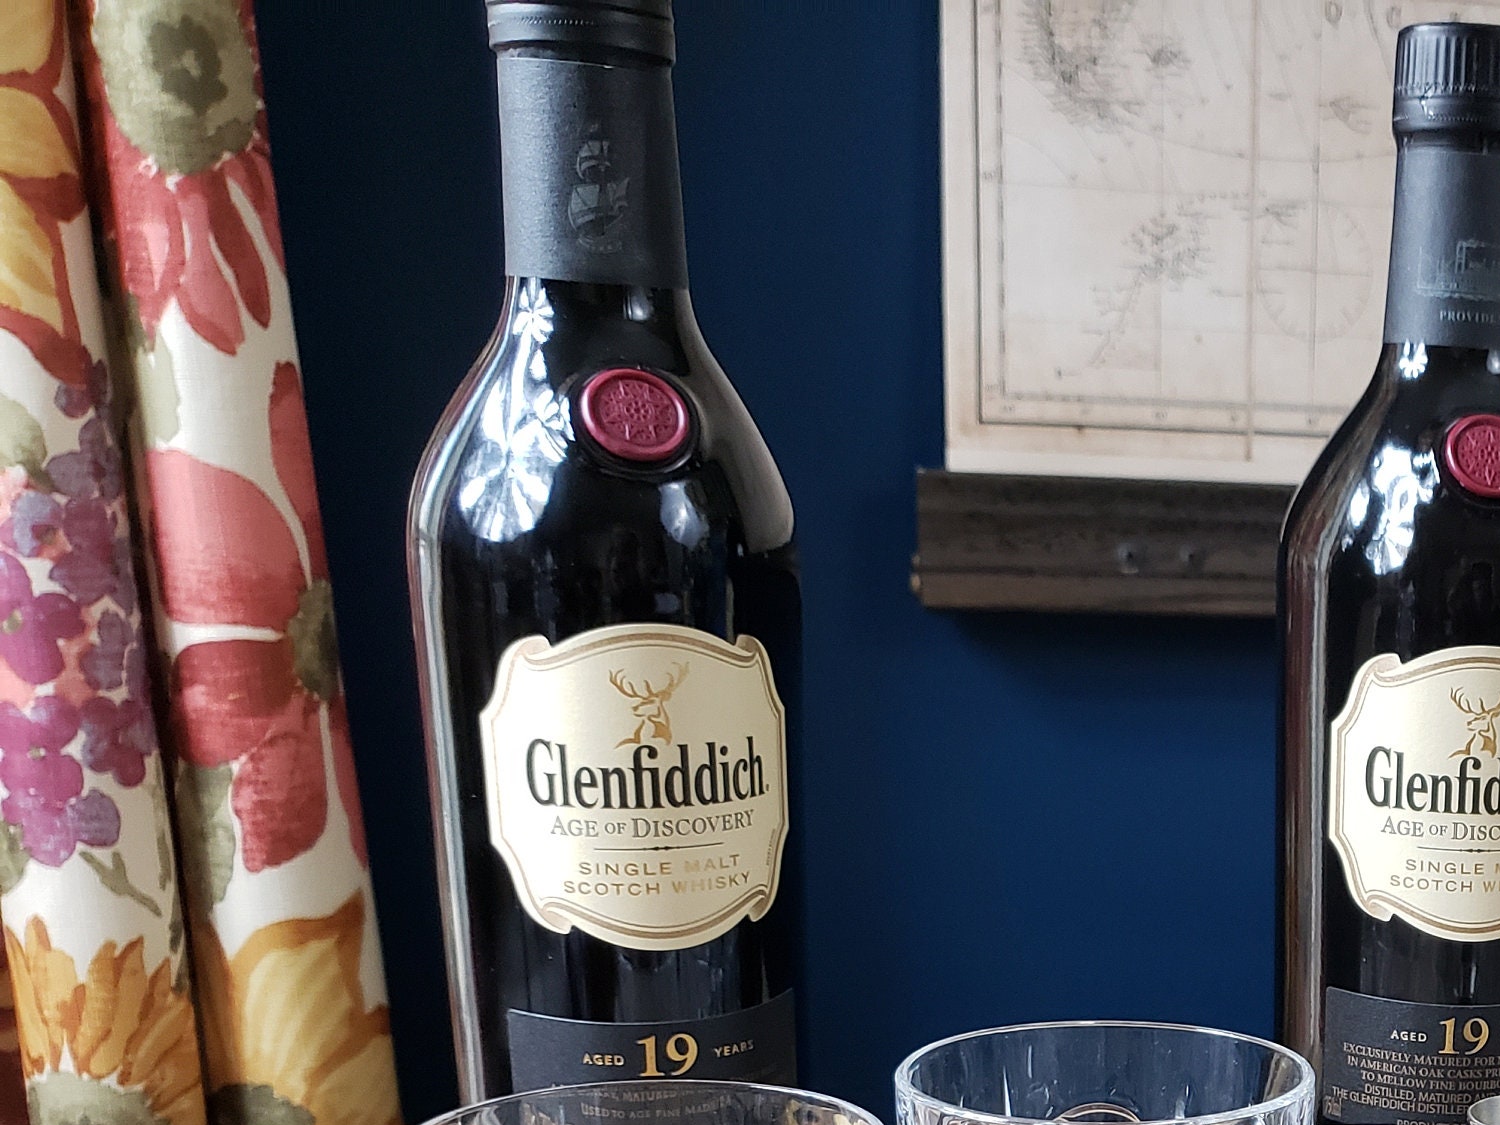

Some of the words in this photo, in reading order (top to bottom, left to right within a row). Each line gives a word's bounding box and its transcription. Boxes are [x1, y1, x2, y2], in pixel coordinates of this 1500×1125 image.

[526, 736, 767, 810] Glenfiddich
[550, 815, 600, 838] AGE
[604, 822, 627, 835] OF
[631, 809, 754, 839] DISCOVERY
[1381, 815, 1425, 838] AGE
[1428, 824, 1449, 837] OF
[579, 861, 672, 876] SINGLE
[683, 854, 740, 873] MALT
[1405, 858, 1485, 875] SINGLE
[564, 880, 661, 896] SCOTCH
[672, 871, 750, 894] WHISKY
[1390, 874, 1473, 893] SCOTCH
[1390, 1029, 1427, 1042] AGED
[1438, 1017, 1490, 1056] 19
[582, 1053, 625, 1067] AGED
[636, 1033, 699, 1077] 19
[714, 1039, 754, 1058] YEARS
[1343, 1042, 1411, 1063] EXCLUSIVELY
[1414, 1054, 1471, 1067] MATURED
[1474, 1056, 1495, 1067] FOR
[1347, 1055, 1358, 1067] IN
[1360, 1058, 1417, 1076] AMERICAN
[1419, 1067, 1445, 1078] OAK
[1447, 1068, 1483, 1079] CASKS
[1361, 1069, 1376, 1081] TO
[1378, 1073, 1427, 1089] MELLOW
[1430, 1080, 1456, 1091] FINE
[1332, 1085, 1349, 1100] THE
[1350, 1091, 1415, 1112] GLENFIDDICH
[1364, 1083, 1417, 1101] DISTILLED,
[1419, 1092, 1472, 1104] MATURED
[581, 1103, 610, 1117] USED
[611, 1109, 625, 1119] TO
[629, 1109, 650, 1119] AGE
[656, 1109, 681, 1119] FINE
